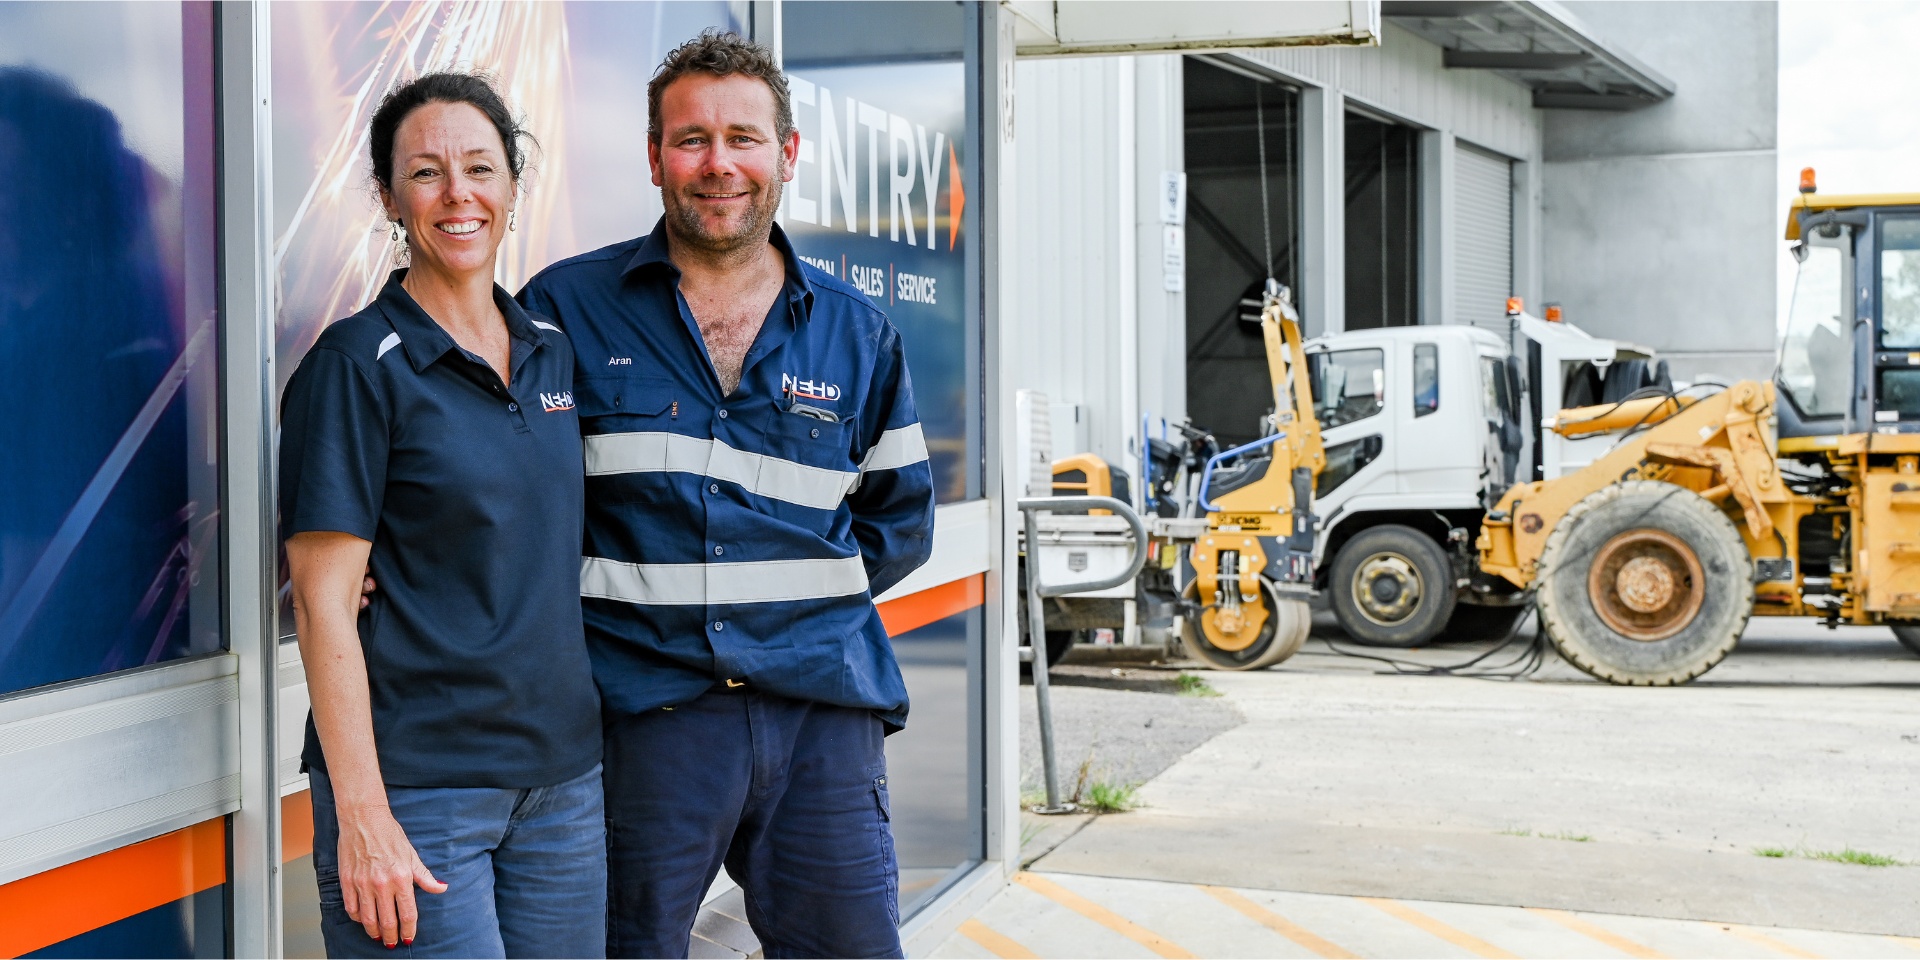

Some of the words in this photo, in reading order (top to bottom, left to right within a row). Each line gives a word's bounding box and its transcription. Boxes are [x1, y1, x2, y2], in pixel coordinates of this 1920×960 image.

[788, 75, 944, 250] ENTRY
[852, 264, 883, 297] SALES
[898, 272, 936, 304] SERVICE
[608, 357, 632, 366] Aran
